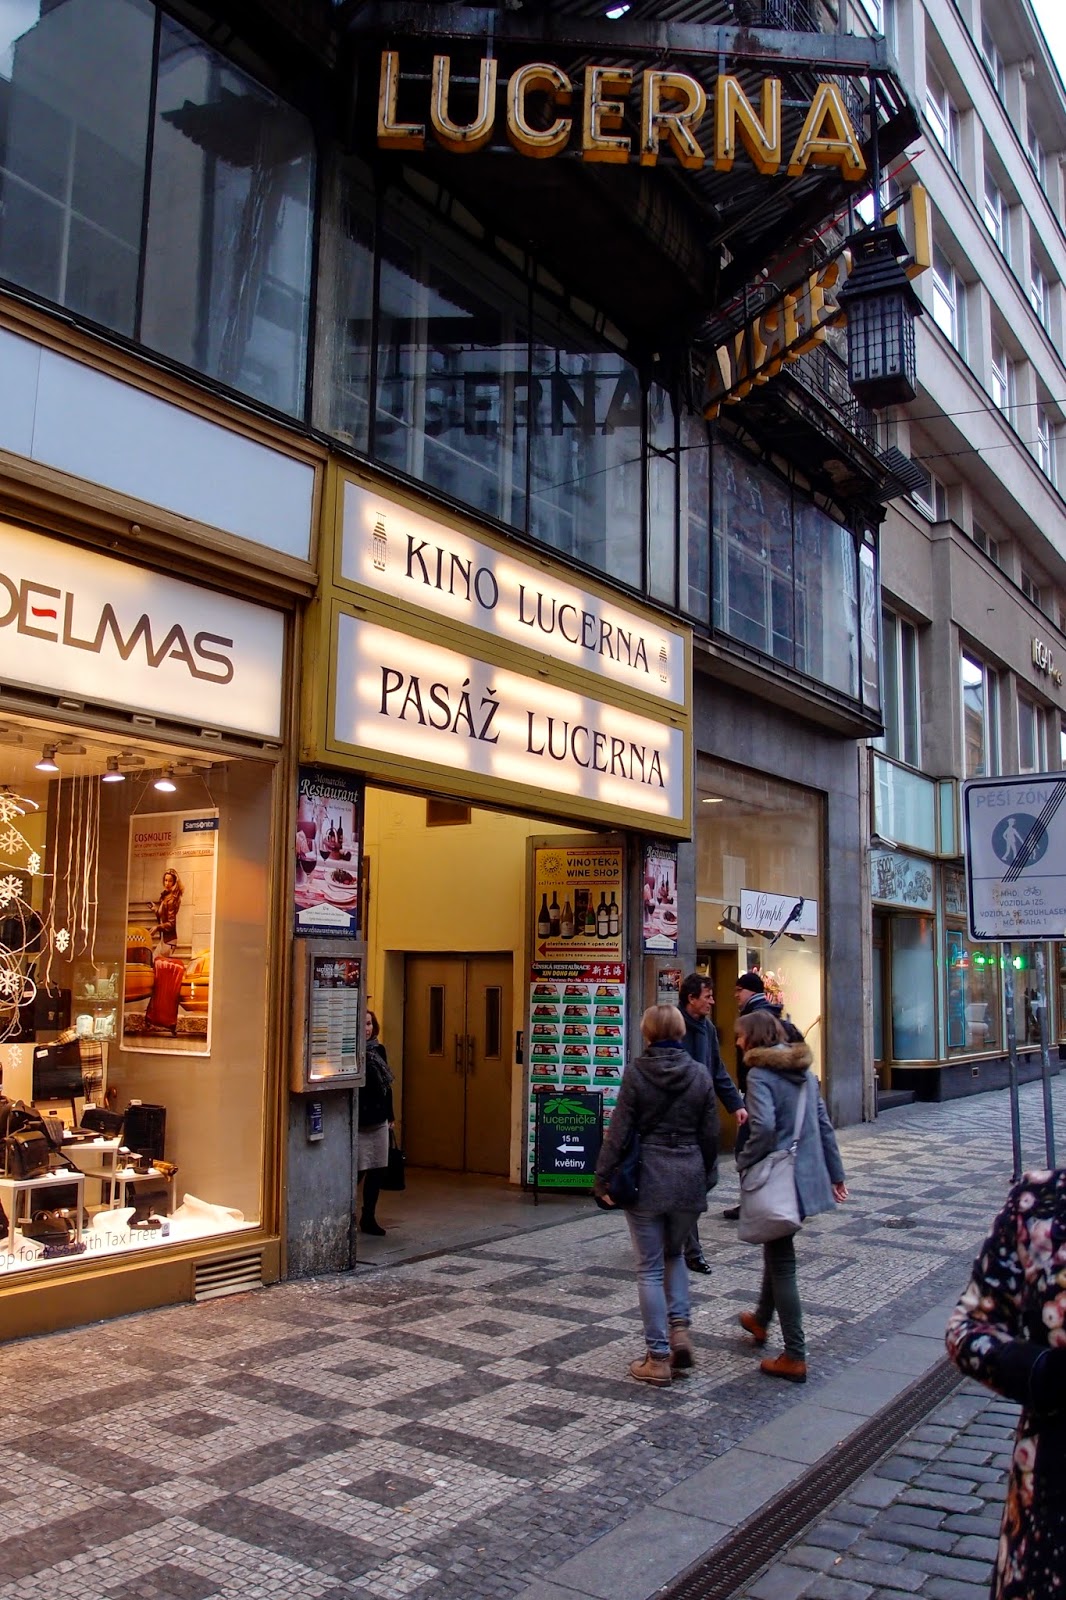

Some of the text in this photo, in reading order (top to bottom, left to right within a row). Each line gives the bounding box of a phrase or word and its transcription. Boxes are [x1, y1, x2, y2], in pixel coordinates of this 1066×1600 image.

[377, 50, 867, 181] LUCERNA
[405, 534, 650, 673] KINO LUCERNA
[379, 665, 666, 788] PASÁŽ LUCERNA
[300, 778, 359, 803] Restaurant
[134, 831, 172, 843] COSMOLITE
[566, 856, 619, 867] VINOTÉKA
[566, 868, 619, 877] WINE SHOP
[1000, 899, 1030, 907] VOZIDLA
[745, 894, 784, 928] Nymph
[980, 910, 1010, 918] VOZIDLA
[1015, 918, 1041, 926] PRAHA
[553, 962, 591, 971] RESTAURACE
[543, 1114, 597, 1125] lucernička
[555, 1124, 584, 1132] flowers
[562, 1135, 571, 1143] 15
[555, 1158, 586, 1169] květiny
[19, 1246, 40, 1262] for
[105, 1231, 126, 1247] Tax
[129, 1228, 157, 1243] Free
